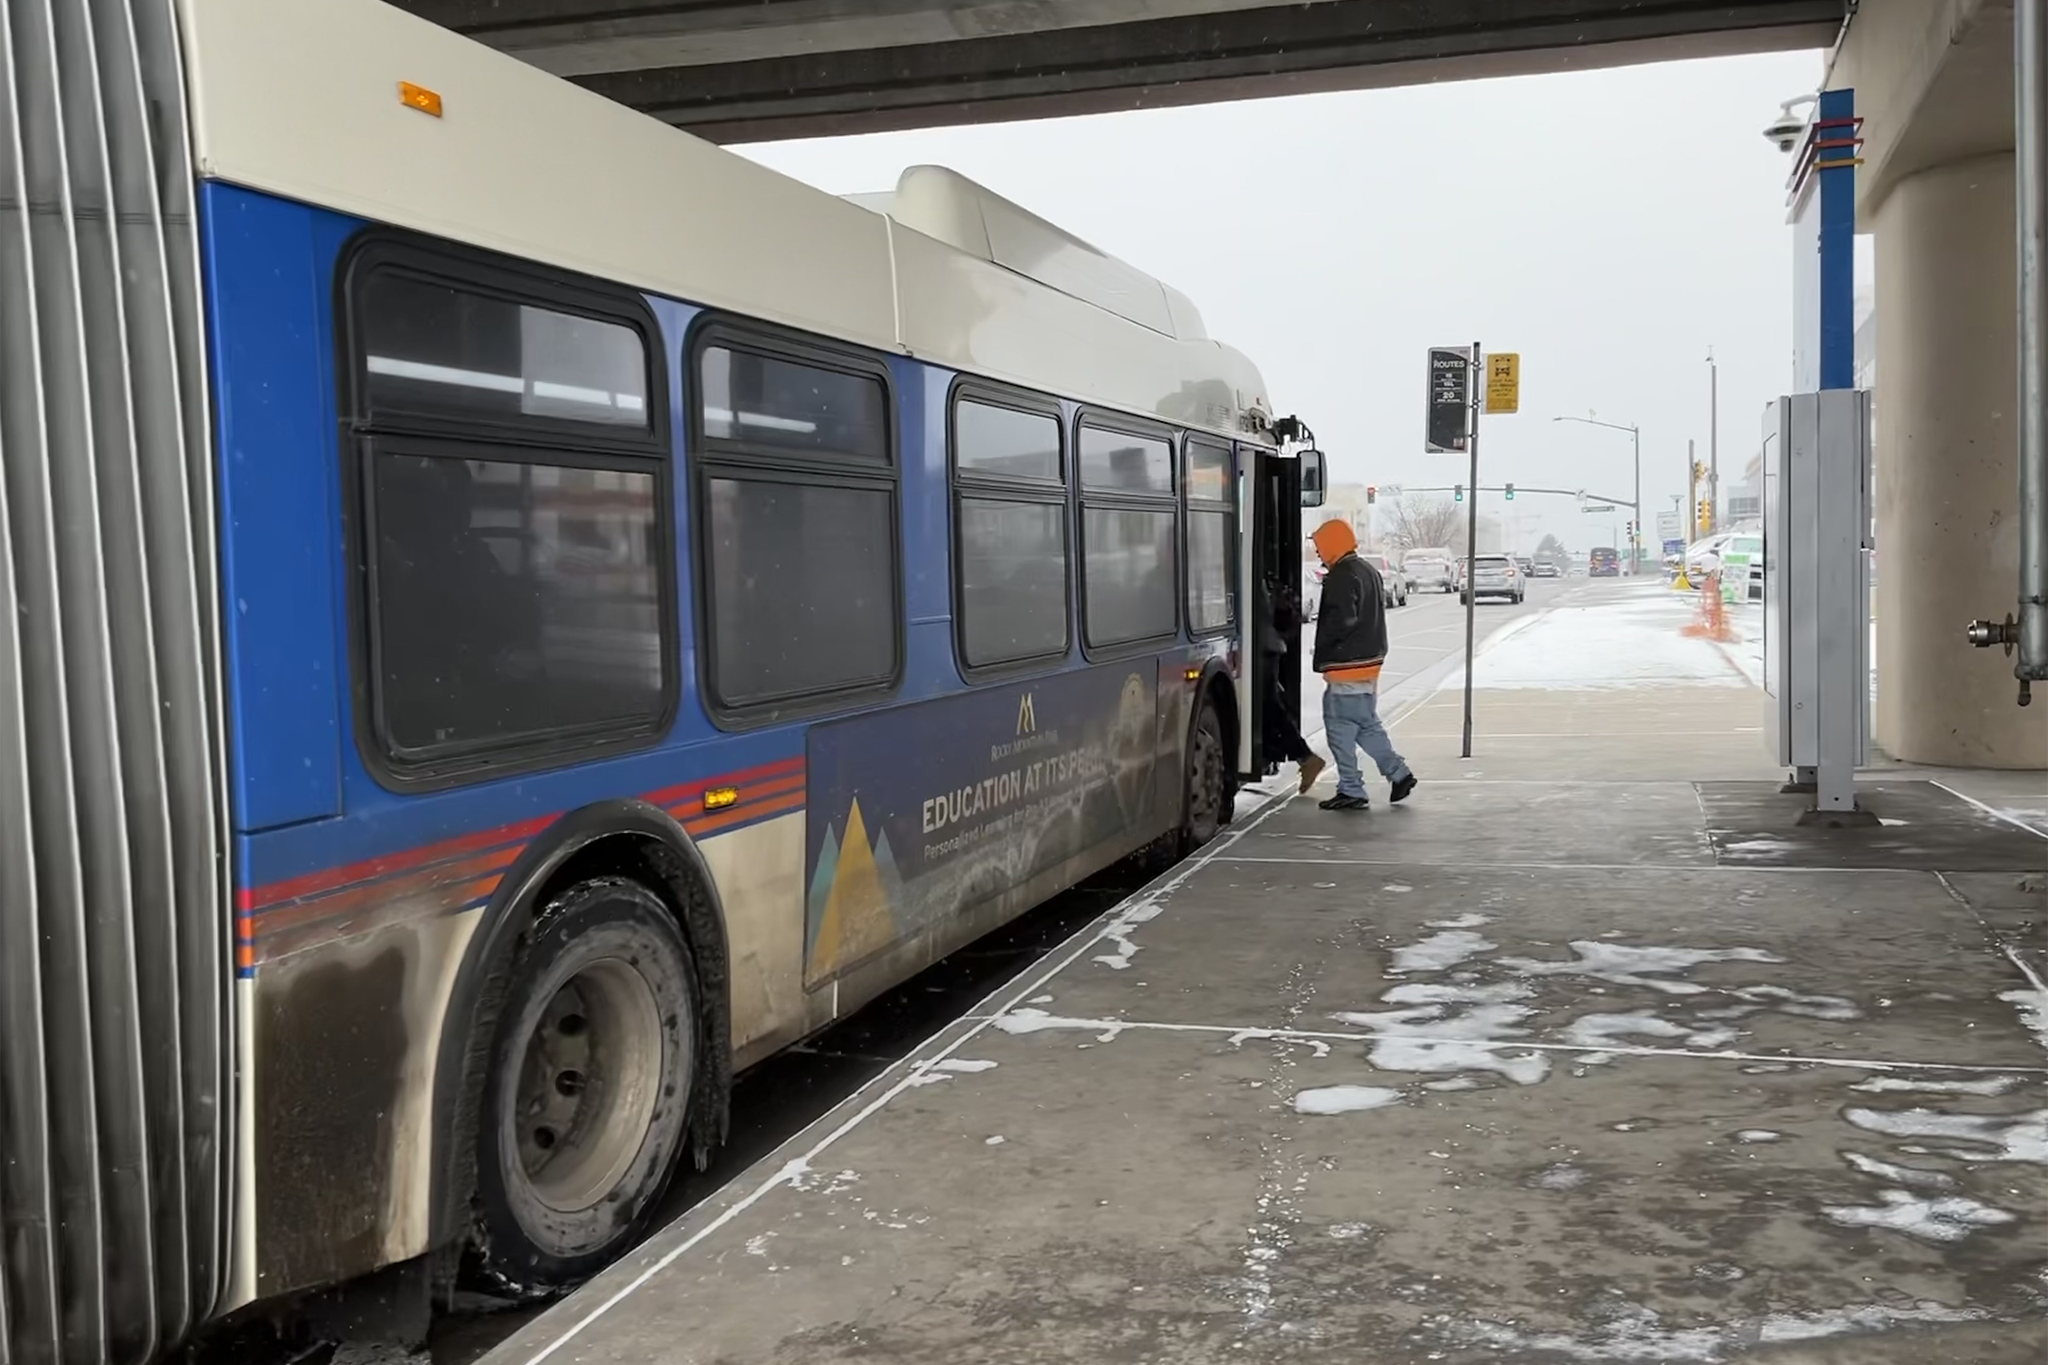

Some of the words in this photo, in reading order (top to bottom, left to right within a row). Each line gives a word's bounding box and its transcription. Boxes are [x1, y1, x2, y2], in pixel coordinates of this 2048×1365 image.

[1433, 360, 1465, 368] ROUTES
[1442, 391, 1455, 399] 20
[923, 771, 1021, 833] EDUCATION
[1024, 761, 1042, 794] AT
[1045, 754, 1066, 785] ITS
[1069, 747, 1107, 777] PE
